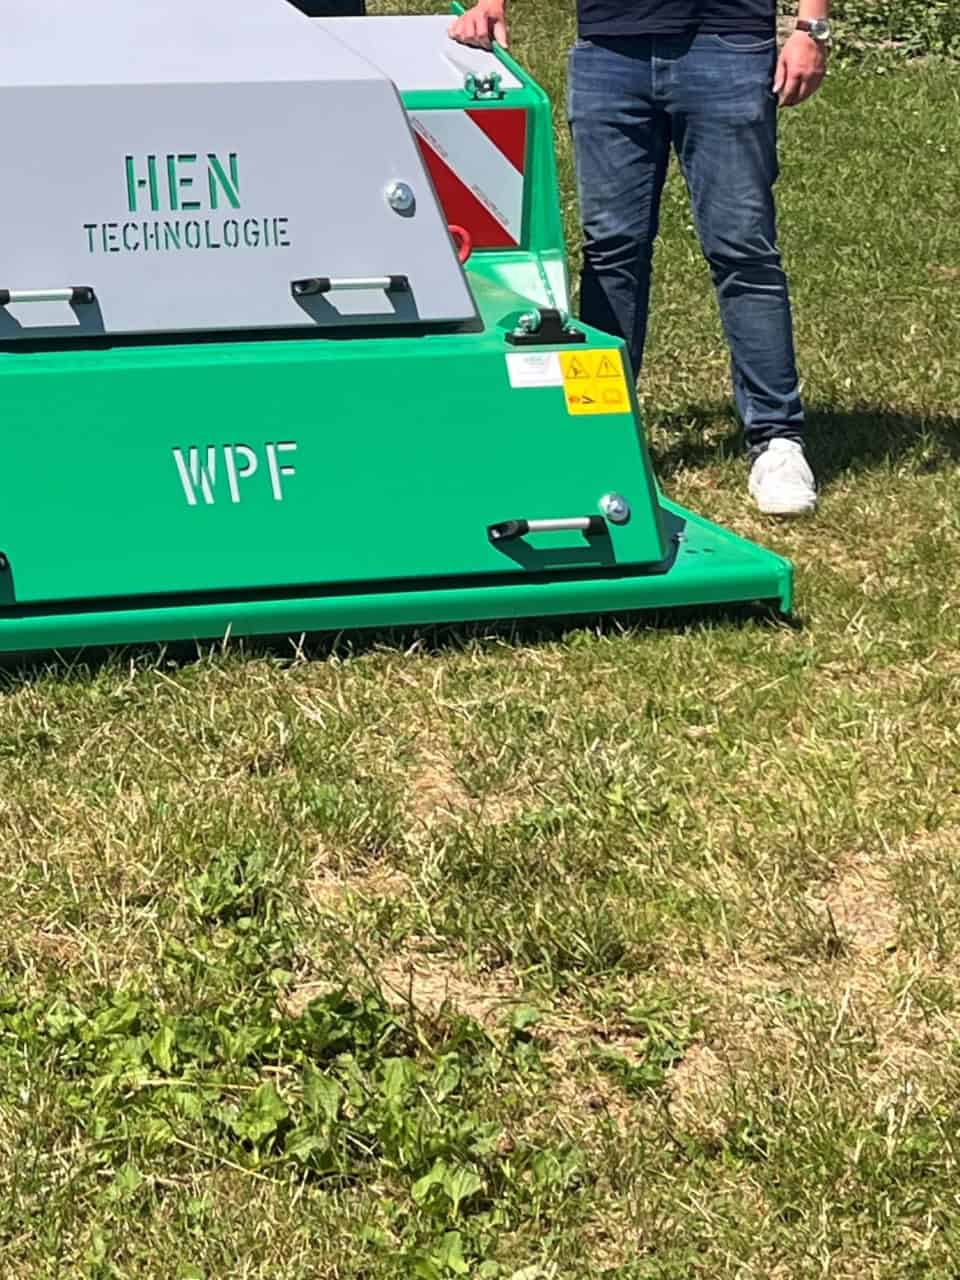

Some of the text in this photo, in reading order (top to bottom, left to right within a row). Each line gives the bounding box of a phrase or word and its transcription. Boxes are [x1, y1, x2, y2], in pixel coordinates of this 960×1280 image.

[125, 153, 241, 211] HEN
[83, 218, 290, 252] TECHNOLOGIE
[171, 441, 297, 506] WPF
